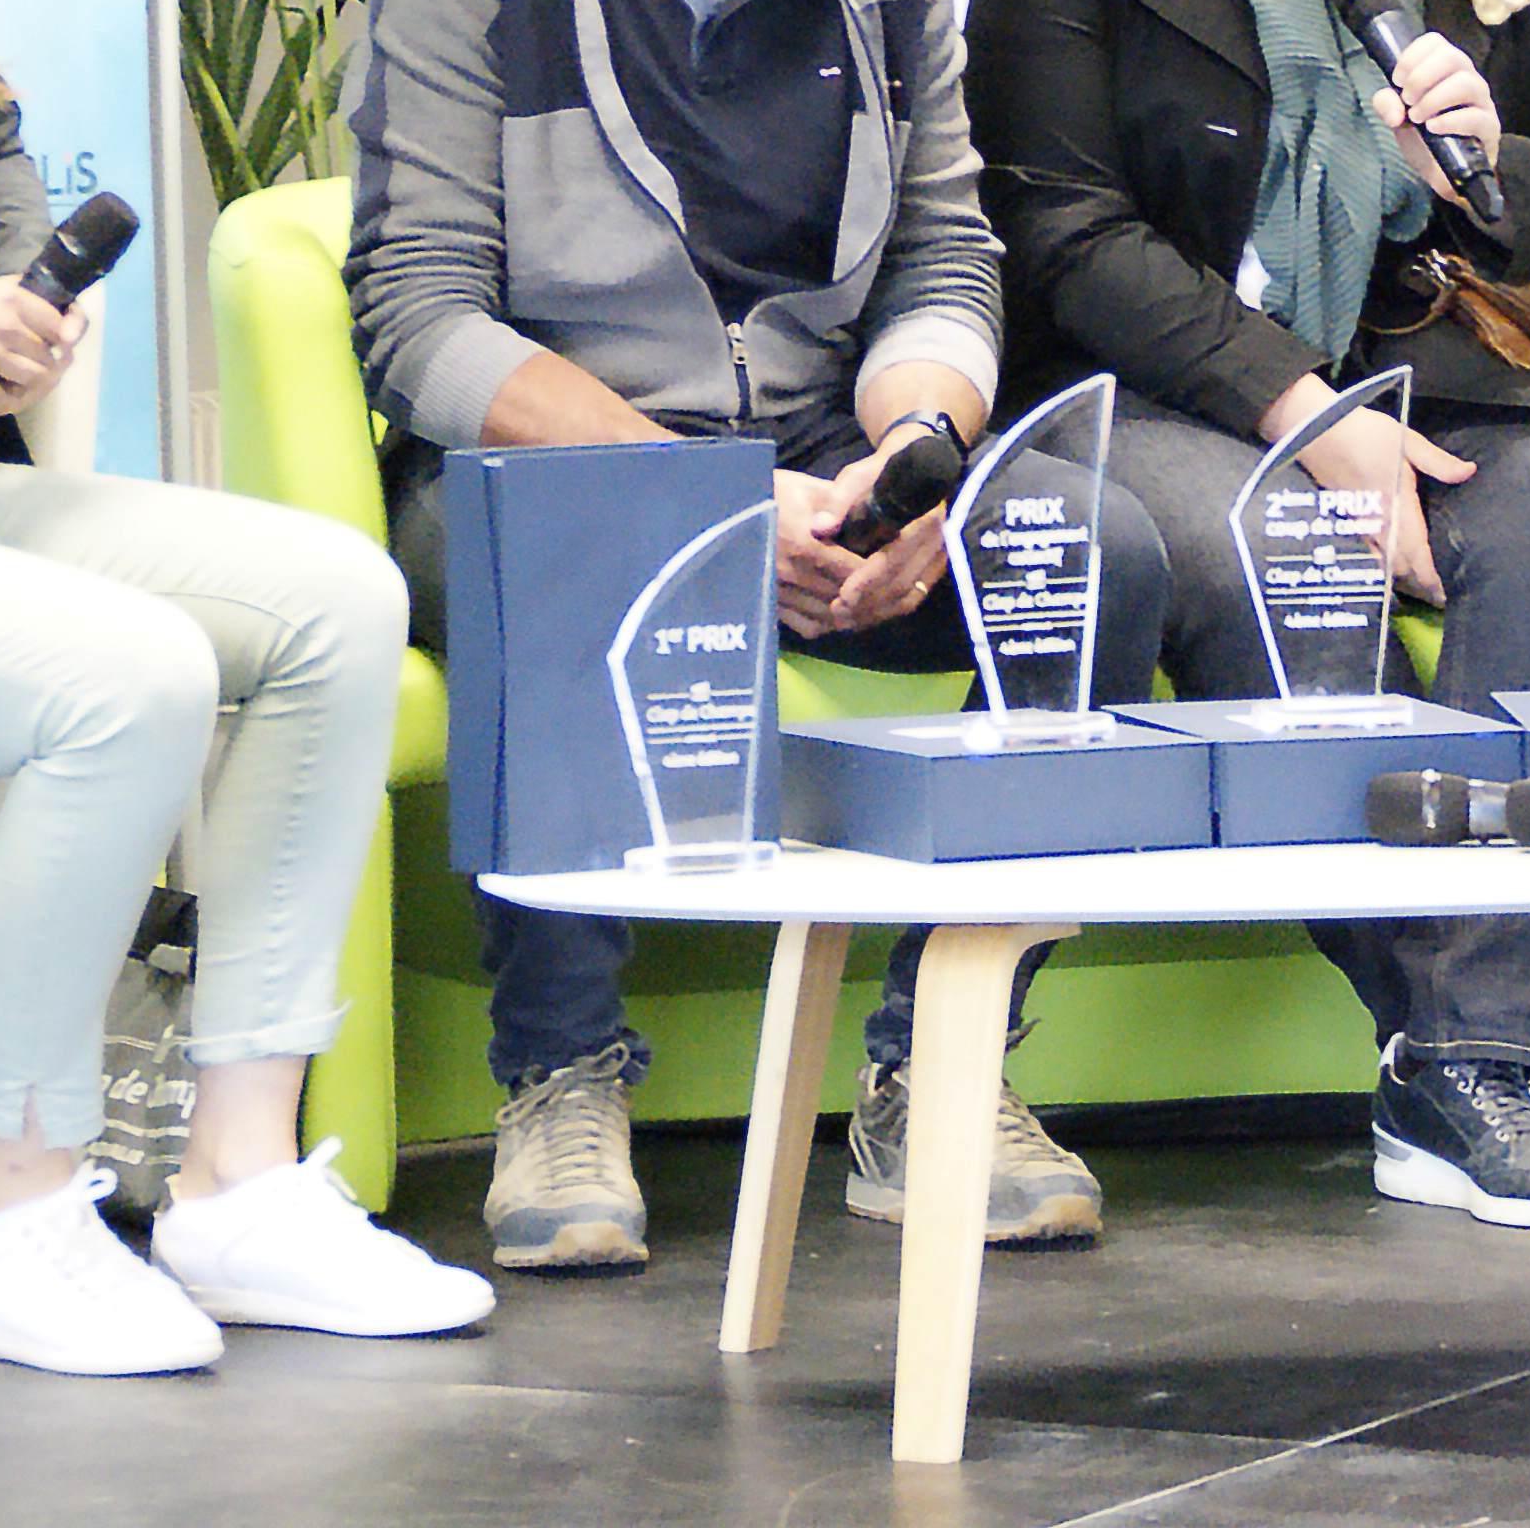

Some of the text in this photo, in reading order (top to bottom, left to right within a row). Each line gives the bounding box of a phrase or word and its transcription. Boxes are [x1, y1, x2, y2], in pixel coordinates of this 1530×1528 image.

[1005, 496, 1066, 527] PRIX
[1319, 490, 1384, 516] PRIX
[687, 624, 748, 654] PRIX
